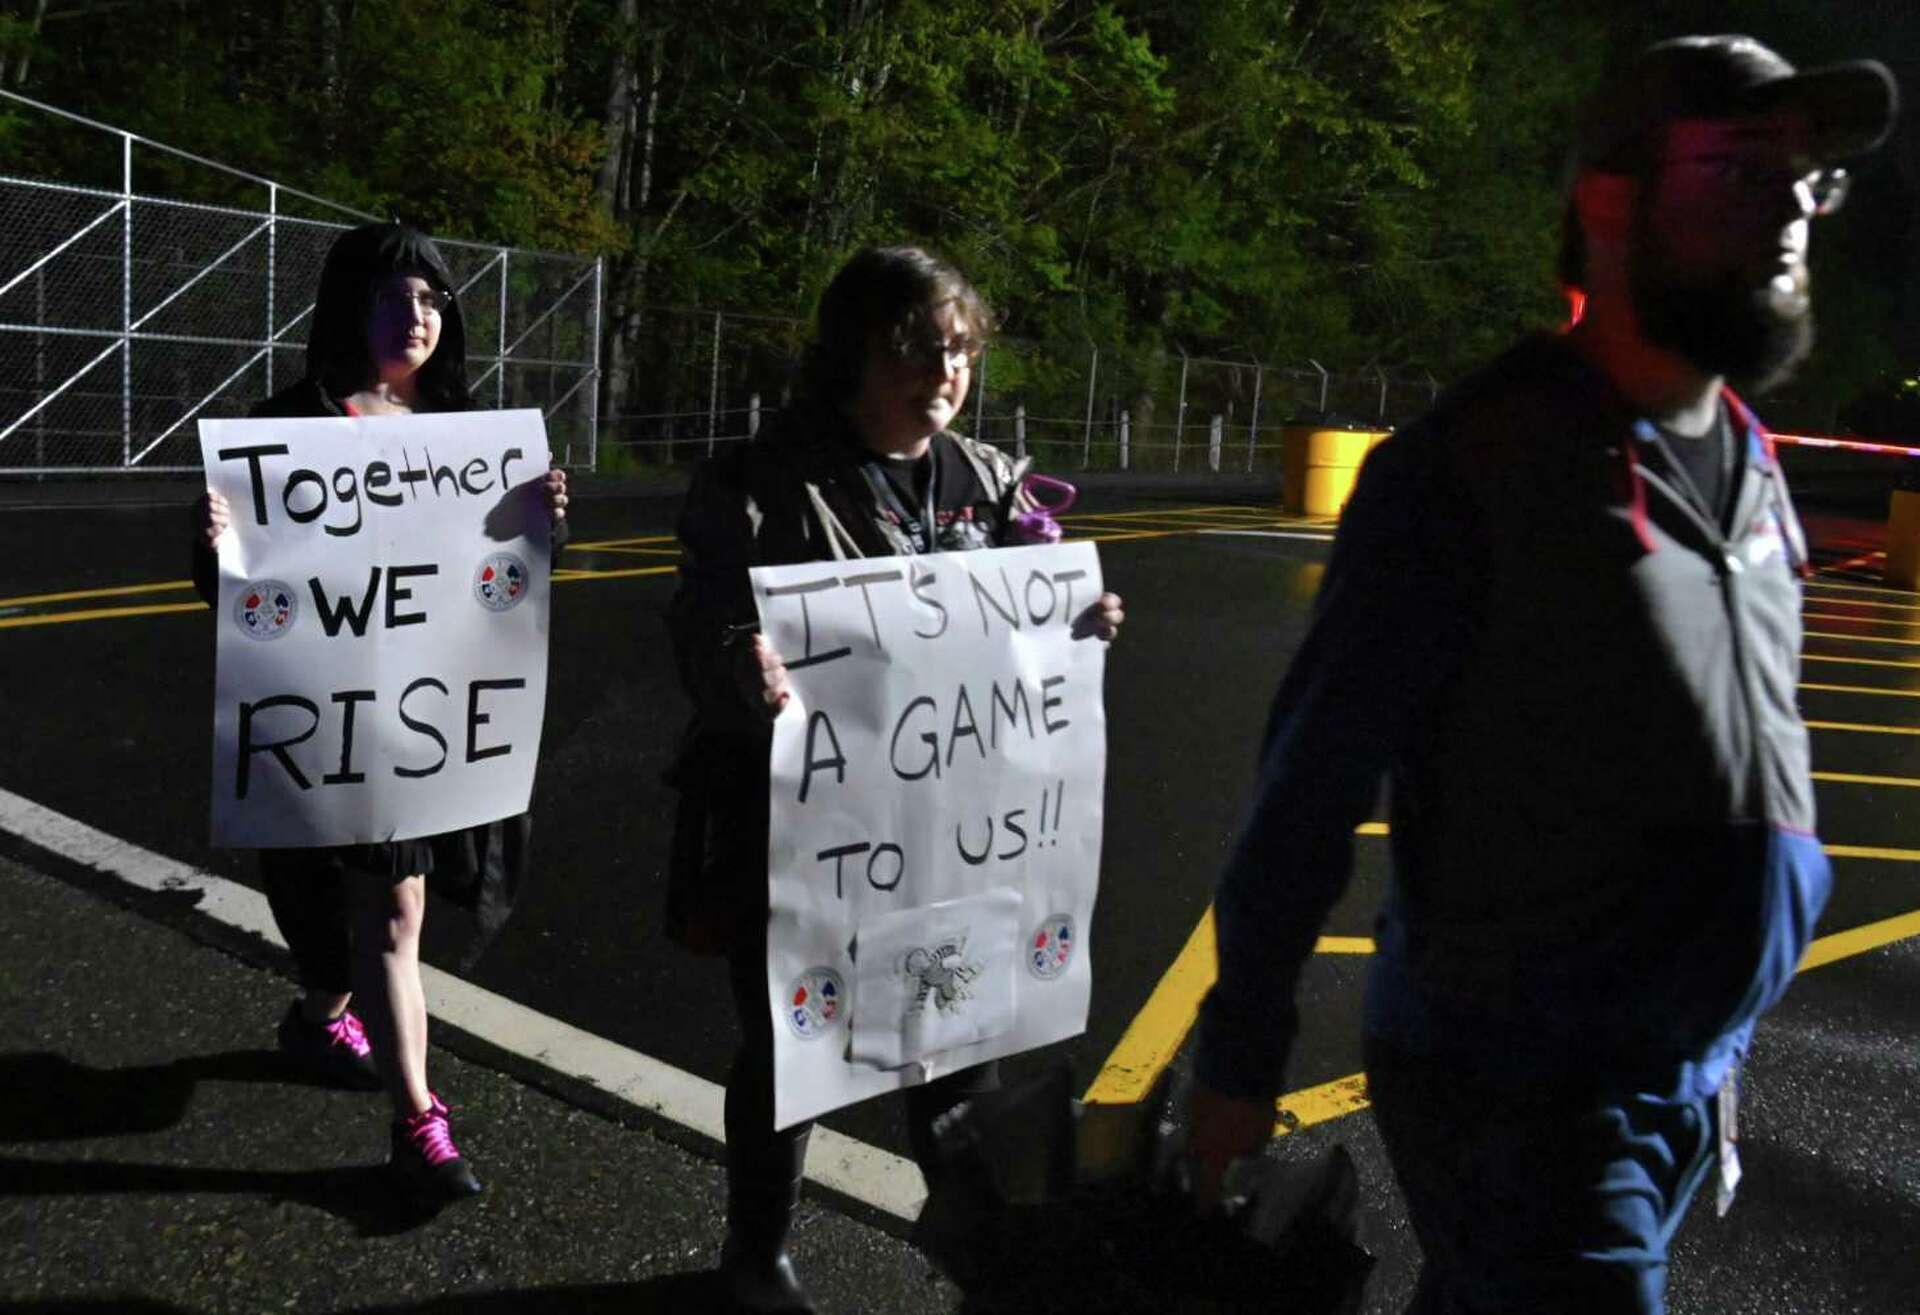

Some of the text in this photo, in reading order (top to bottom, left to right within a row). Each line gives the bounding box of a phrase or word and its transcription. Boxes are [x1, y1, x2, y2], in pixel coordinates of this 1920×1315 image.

[218, 443, 523, 537] Together
[308, 564, 438, 637] WE
[765, 563, 1087, 671] IT'S NOT
[236, 677, 526, 799] RISE
[797, 675, 1071, 803] A GAME
[817, 780, 1064, 899] TO US!!
